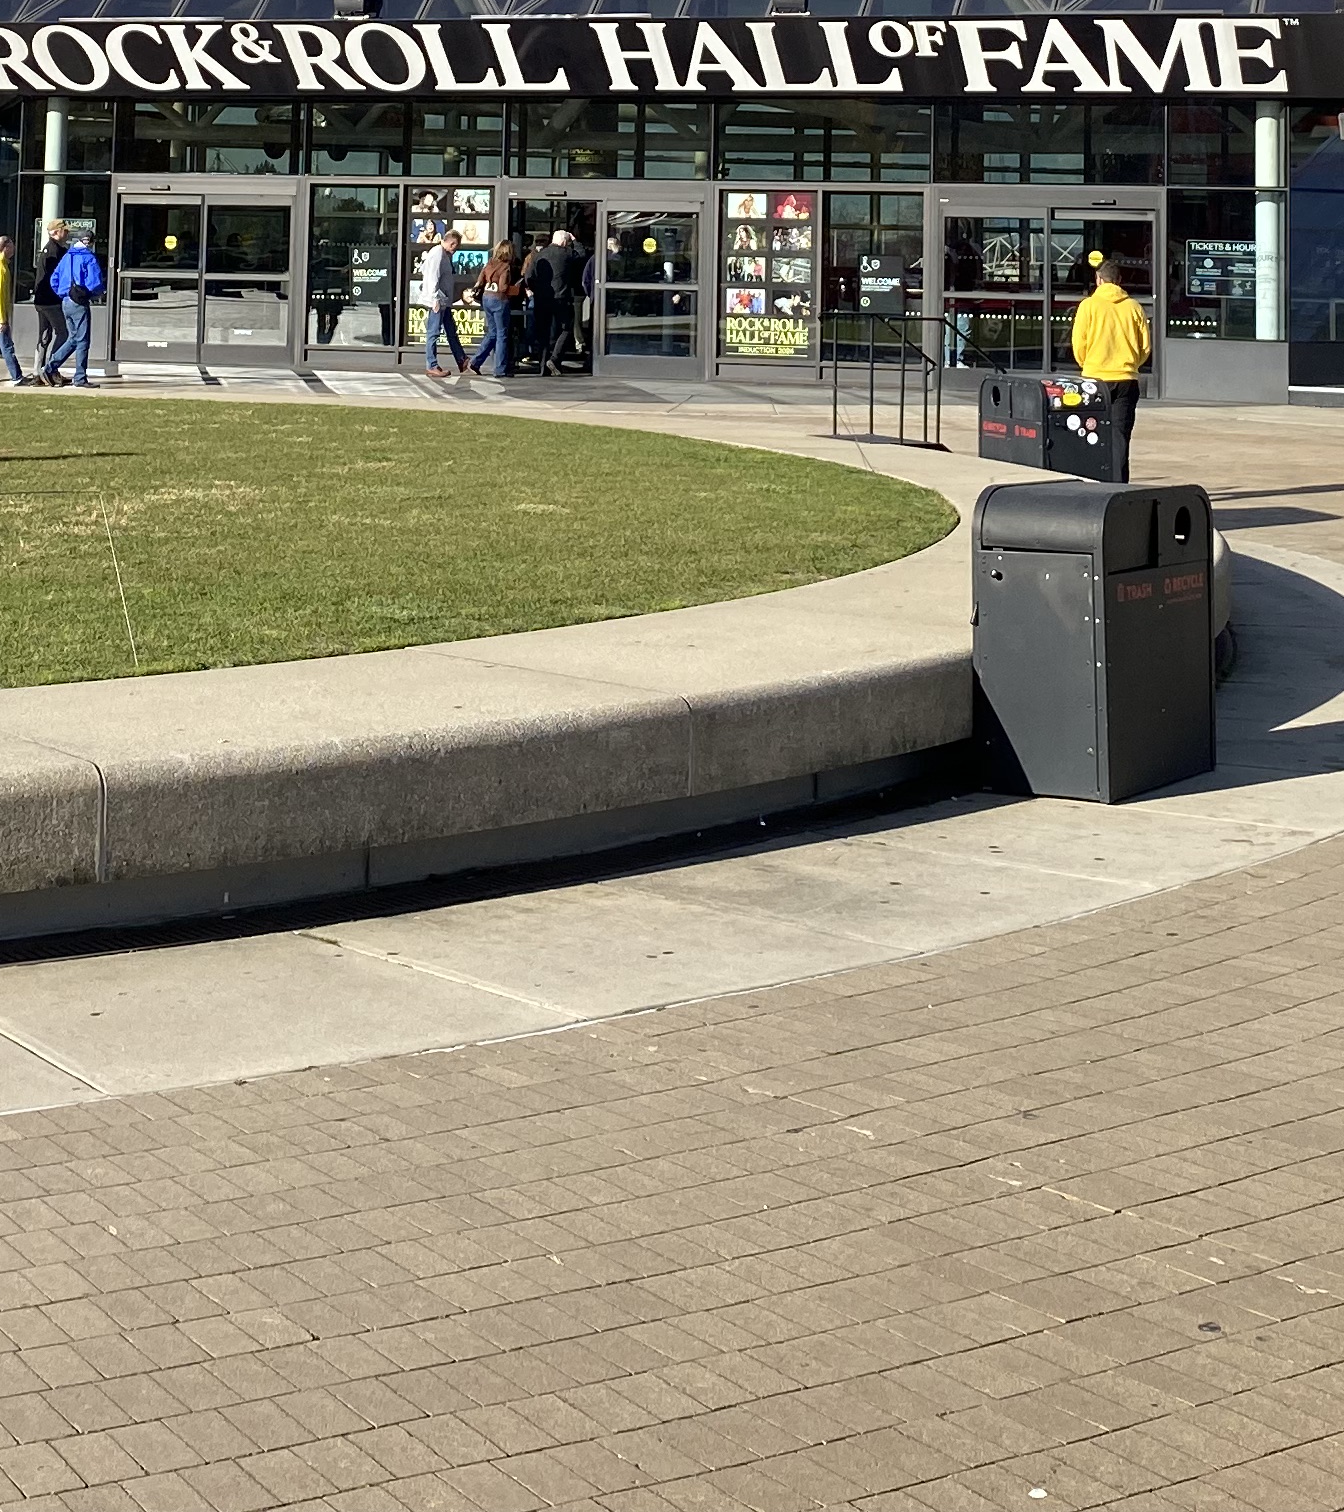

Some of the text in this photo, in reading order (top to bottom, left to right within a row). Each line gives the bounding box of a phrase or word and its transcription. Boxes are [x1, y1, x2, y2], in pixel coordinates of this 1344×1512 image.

[589, 21, 904, 92] HALL
[868, 20, 946, 57] OF
[948, 18, 1289, 94] FAME
[1189, 242, 1224, 251] TICKETS
[1232, 244, 1257, 252] HOUR
[353, 268, 387, 277] WELCOME
[861, 277, 901, 286] WELCOME
[409, 308, 429, 321] RO
[408, 320, 485, 335] HA AME
[1126, 583, 1152, 600] TRASH
